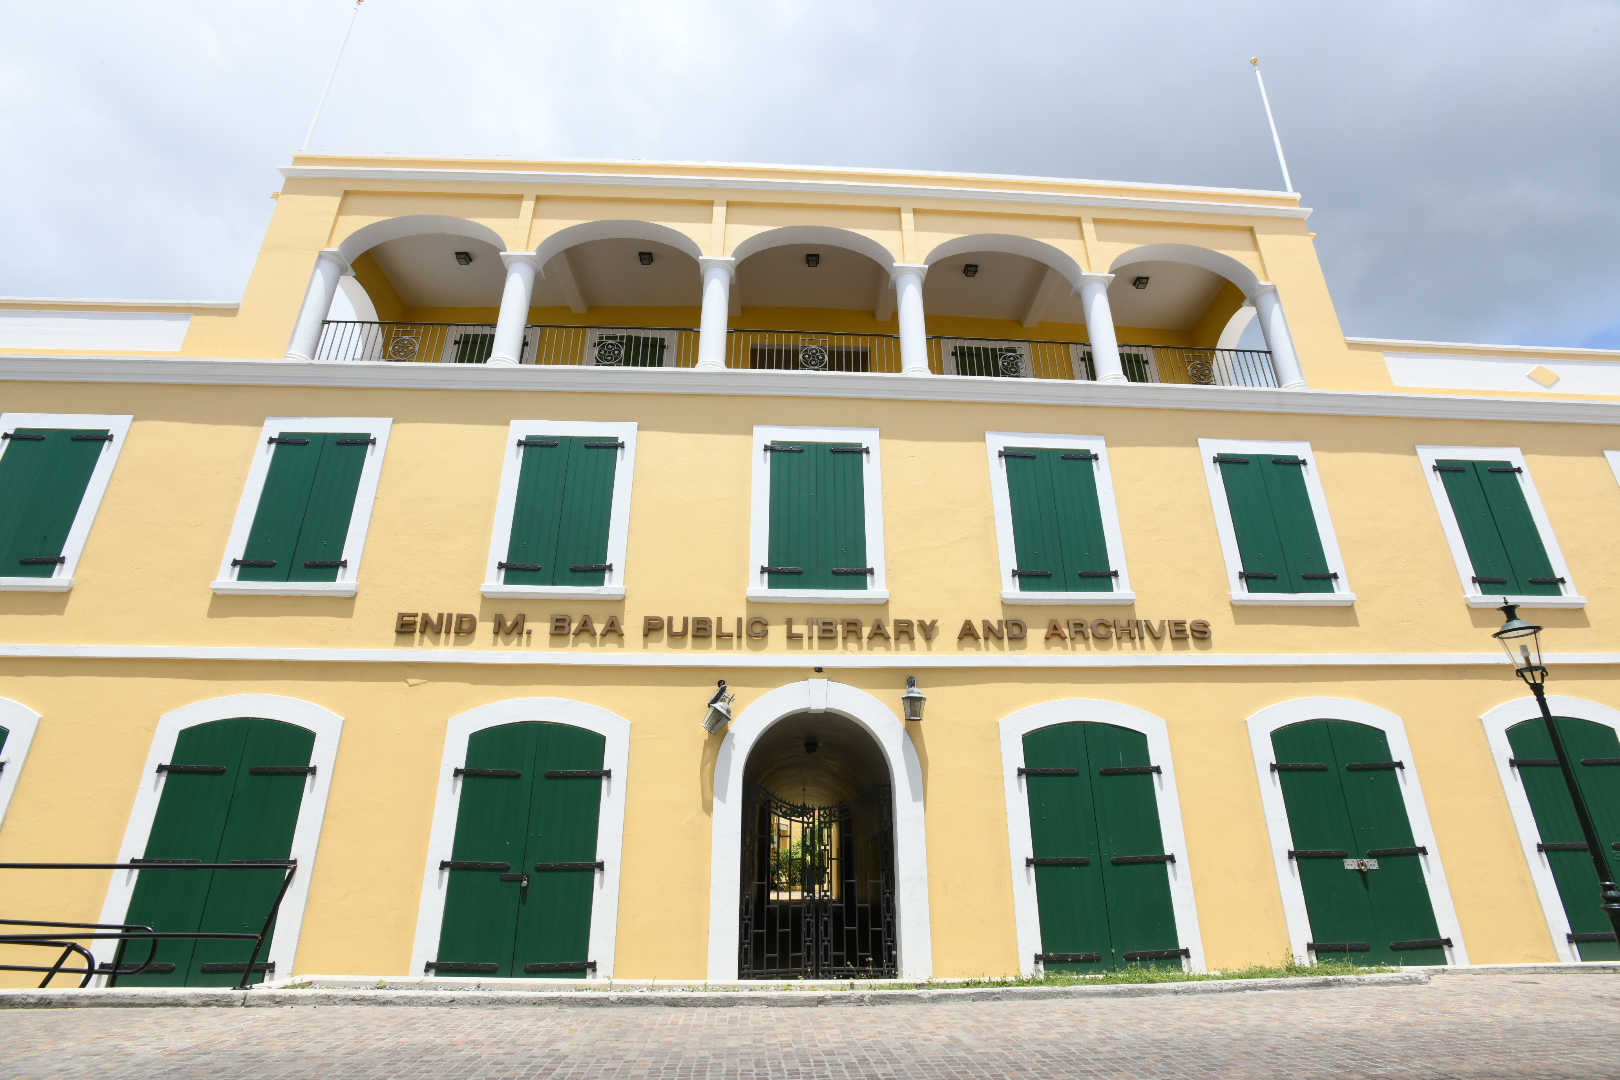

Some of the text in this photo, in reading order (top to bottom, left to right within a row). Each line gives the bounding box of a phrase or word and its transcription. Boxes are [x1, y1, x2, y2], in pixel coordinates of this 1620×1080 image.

[394, 612, 1212, 642] ENID M. BAA PUBLIC LIBRARY AND ARCHIVES
